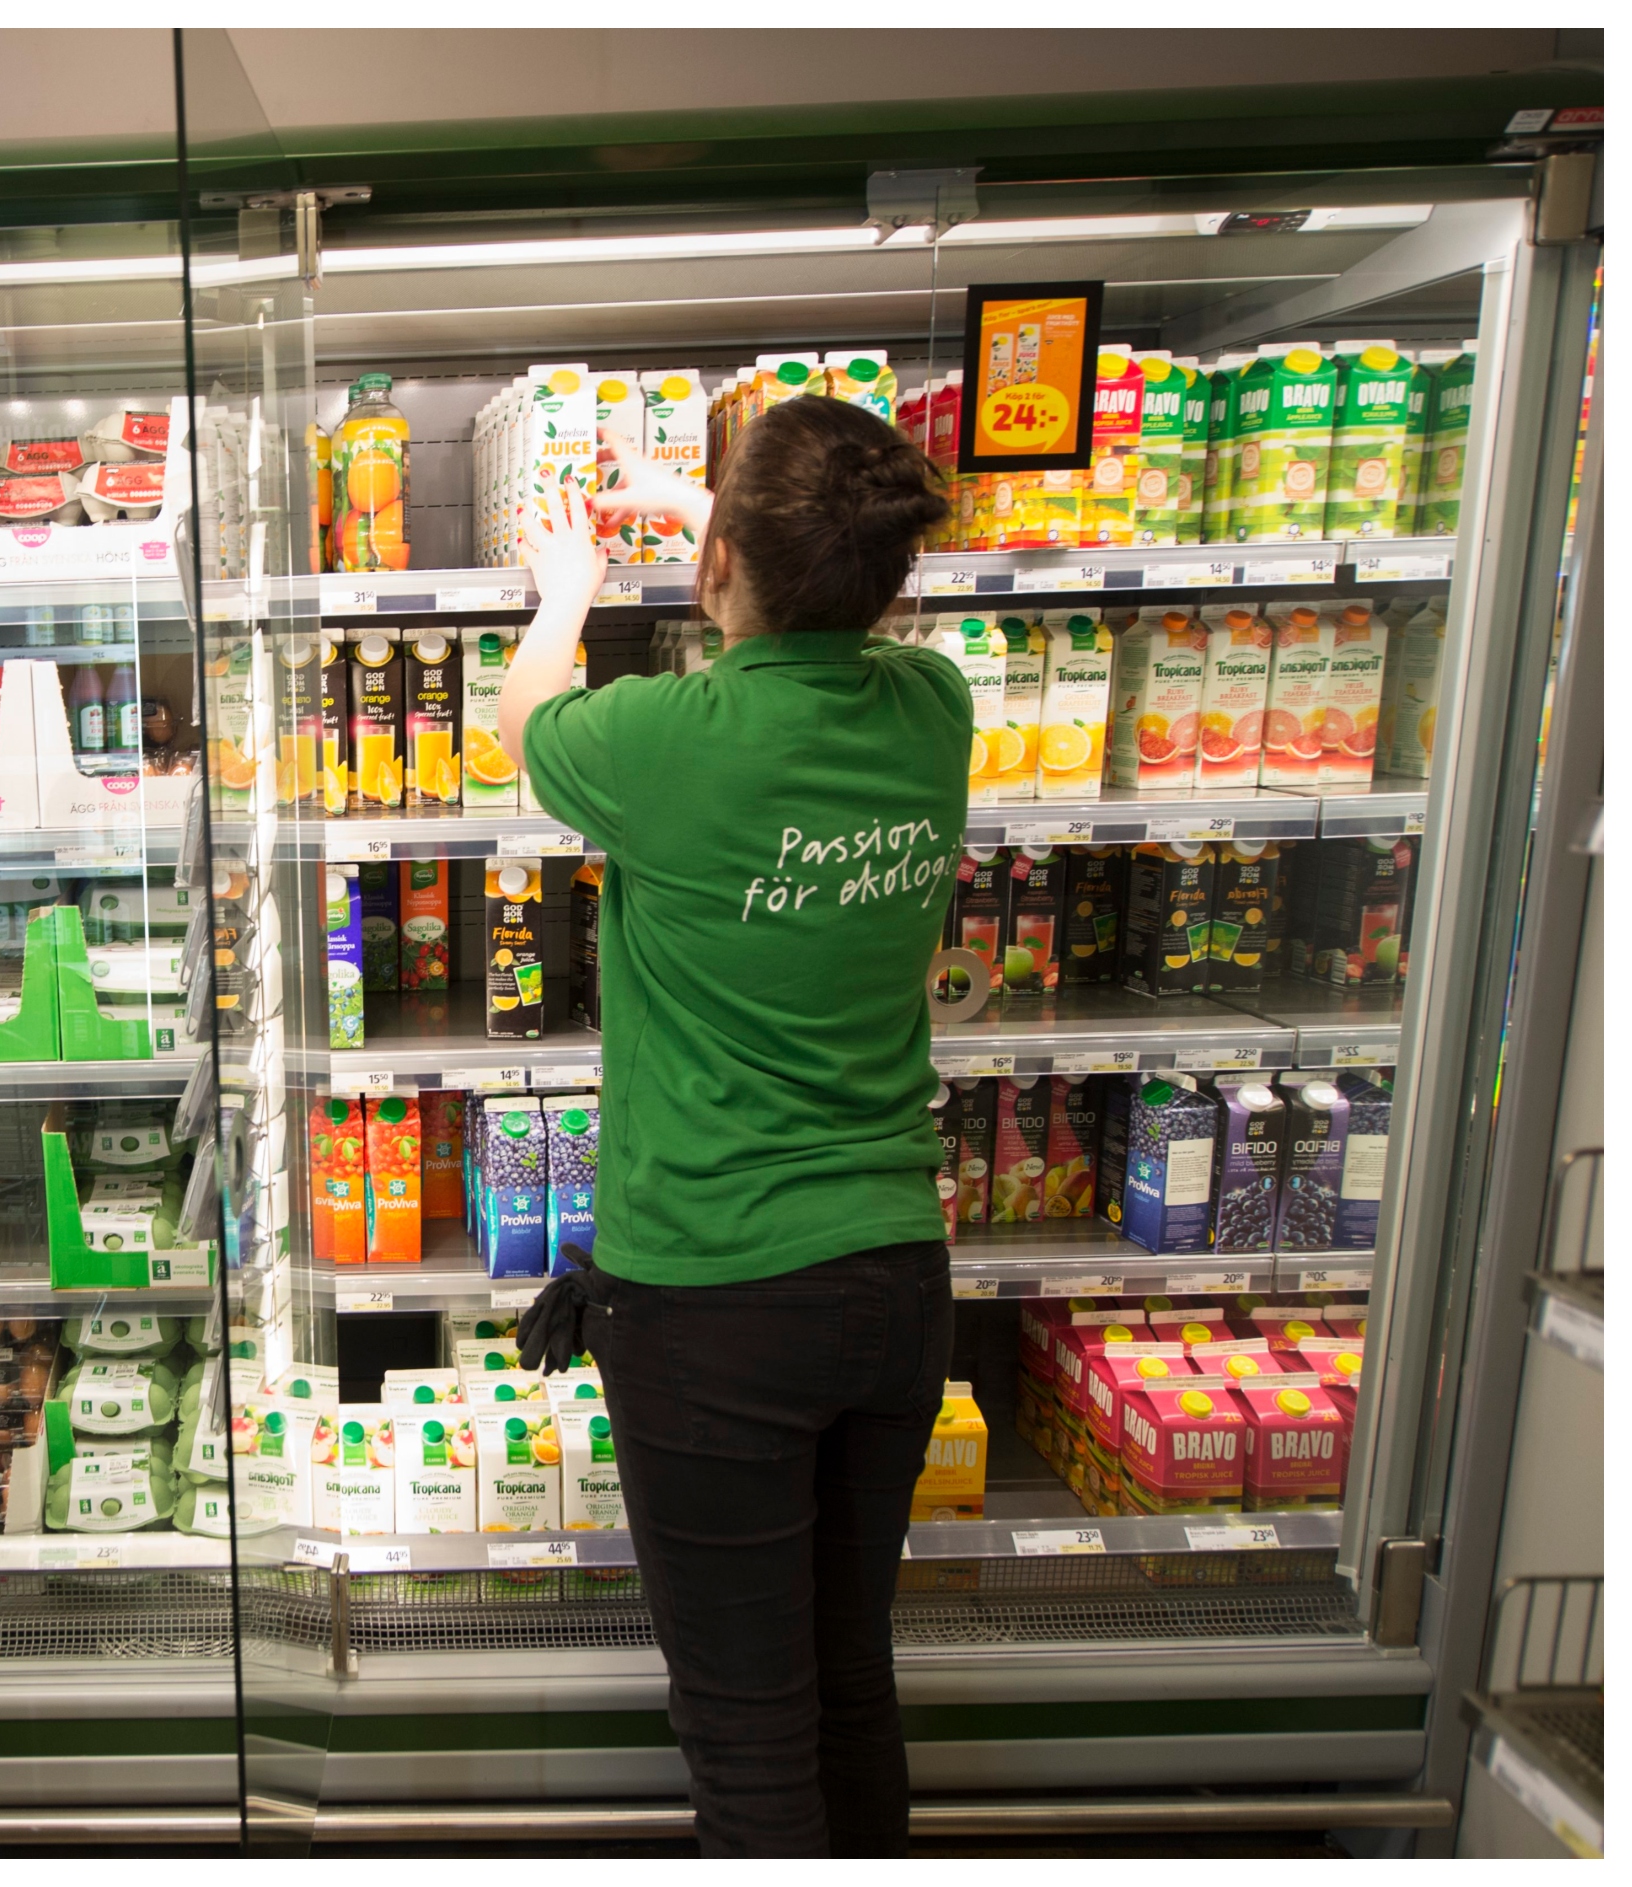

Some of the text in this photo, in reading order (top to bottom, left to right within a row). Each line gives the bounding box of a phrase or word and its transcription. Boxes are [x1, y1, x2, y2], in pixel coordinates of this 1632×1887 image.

[1005, 393, 1023, 401] Köp
[1282, 383, 1330, 407] BRAVO
[992, 403, 1058, 431] 24:-
[132, 425, 140, 434] 6
[558, 427, 588, 439] apelsin
[668, 433, 698, 444] apelsin
[541, 440, 591, 456] JUICE
[651, 446, 701, 460] JUICE
[96, 551, 131, 563] HÖNS
[1080, 566, 1102, 578] 1450
[1210, 563, 1231, 574] 1450
[951, 572, 974, 583] 2295
[618, 581, 640, 593] 1450
[1056, 667, 1107, 682] Tropicana
[1153, 663, 1202, 679] Tropicana
[1216, 661, 1266, 676] Tropicana
[360, 695, 391, 704] orange
[417, 692, 448, 701] orange
[106, 781, 135, 791] coop
[70, 800, 179, 814] ÄGG FRÅN SVENSKA
[1068, 822, 1091, 833] 2995
[1209, 817, 1232, 831] 2995
[559, 834, 581, 846] 2995
[1215, 831, 1231, 839] 29.95
[367, 841, 388, 853] 1695
[777, 818, 939, 869] Passion
[742, 876, 818, 922] för
[1170, 889, 1205, 901] Florida
[407, 922, 442, 933] Sagolika
[492, 926, 534, 940] Florida
[1113, 1052, 1134, 1063] 1950
[1234, 1048, 1257, 1059] 2250
[992, 1057, 1013, 1068] 1695
[368, 1074, 388, 1084] 1550
[500, 1070, 520, 1080] 1495
[1002, 1116, 1045, 1129] BIFIDO
[1053, 1111, 1096, 1124] BIFIDO
[1231, 1142, 1277, 1154] BIFIDO
[967, 1164, 986, 1172] New!
[1025, 1163, 1043, 1172] New!
[1245, 1159, 1276, 1168] blueberry
[1128, 1176, 1160, 1199] ProViva
[378, 1198, 418, 1210] ProViva
[500, 1214, 542, 1227] ProViva
[511, 1227, 531, 1235] Blåbär
[1101, 1275, 1123, 1286] 2095
[1223, 1273, 1245, 1284] 2095
[975, 1280, 997, 1290] 2095
[1225, 1412, 1241, 1422] 2L
[1322, 1410, 1339, 1421] 2L
[1124, 1402, 1156, 1455] BRAVO
[1173, 1431, 1237, 1461] BRAVO
[1271, 1430, 1335, 1460] BRAVO
[1174, 1470, 1233, 1480] TROPISK JUICE
[1272, 1469, 1330, 1479] TROPISK JUICE
[410, 1481, 461, 1495] Tropicana
[494, 1480, 546, 1494] Tropicana
[1077, 1531, 1099, 1543] 2350
[1251, 1529, 1274, 1542] 2350
[548, 1542, 571, 1555] 4495
[386, 1551, 408, 1562] 4495
